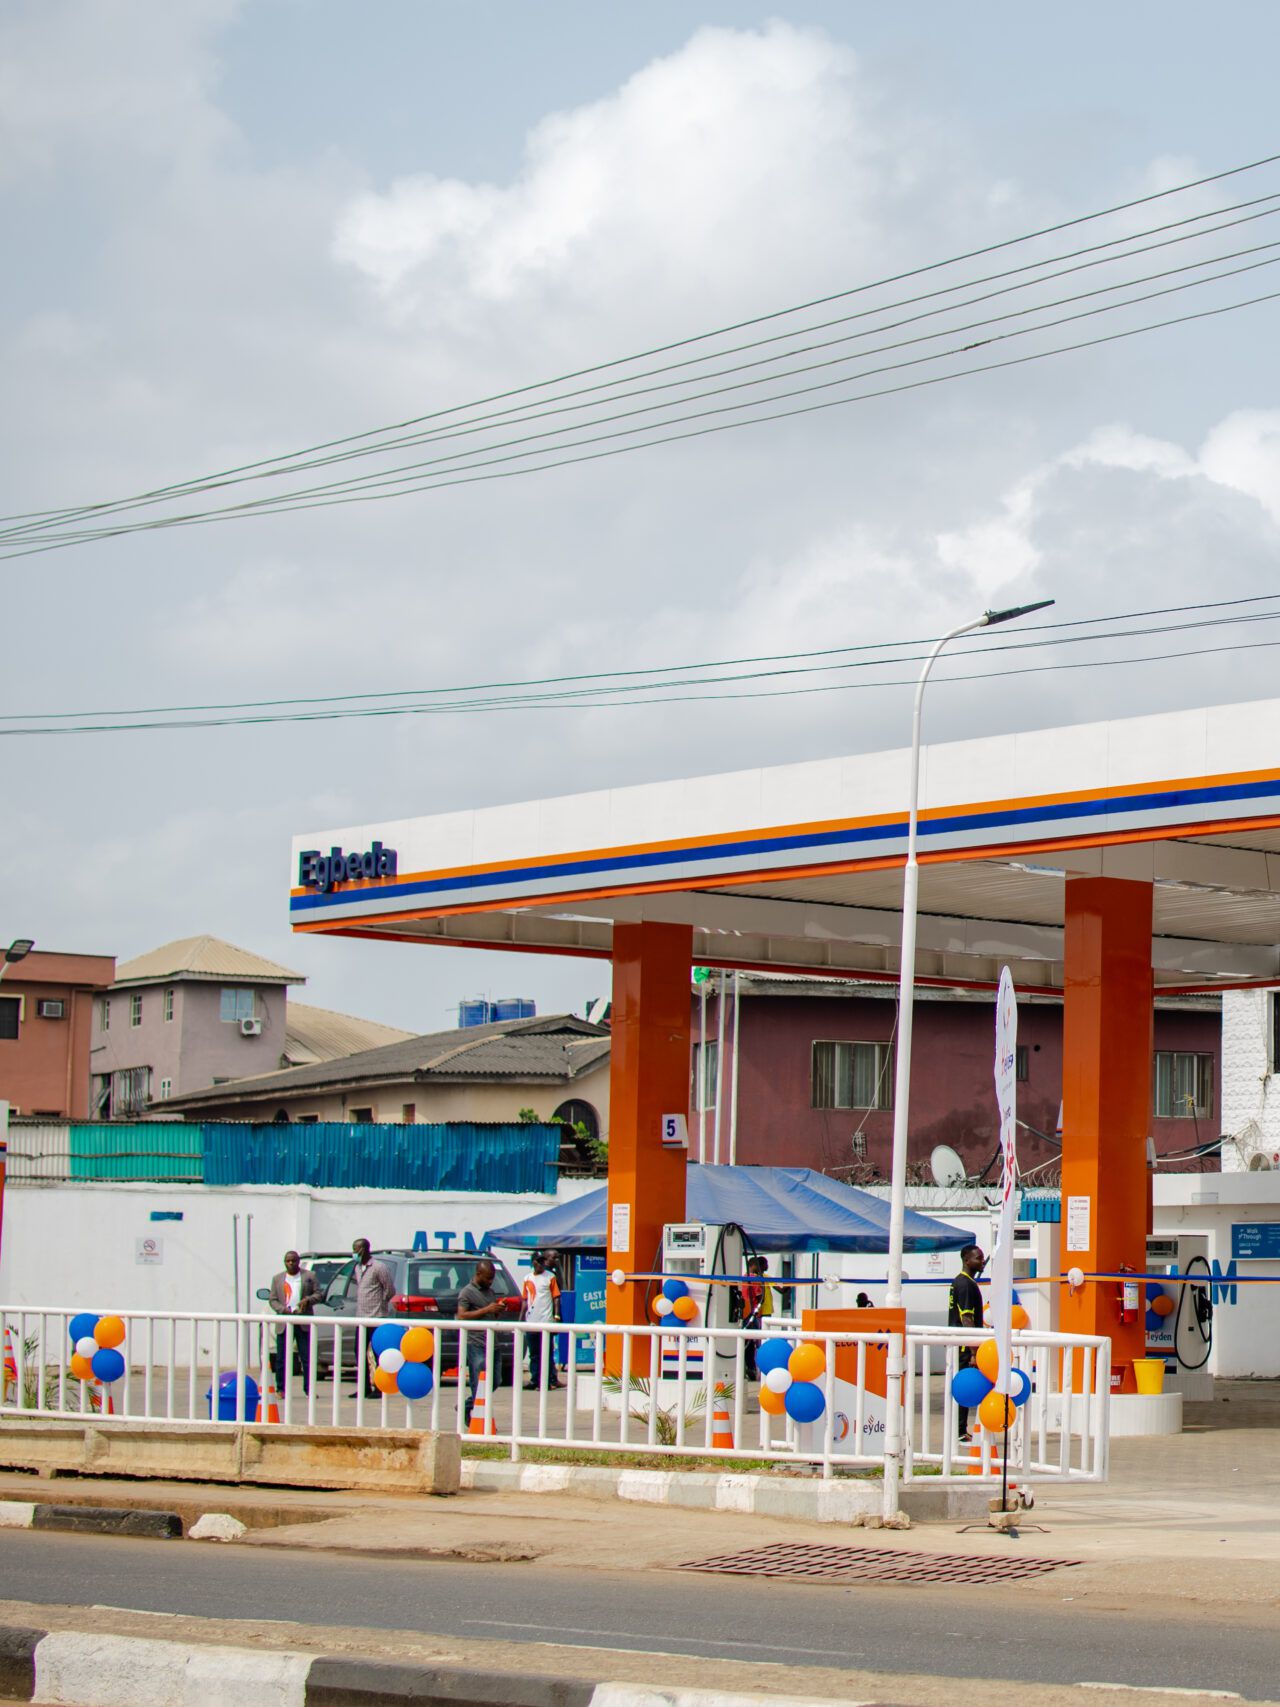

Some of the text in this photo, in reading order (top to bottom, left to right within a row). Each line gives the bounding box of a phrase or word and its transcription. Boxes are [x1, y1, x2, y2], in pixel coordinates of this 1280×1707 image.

[298, 841, 397, 893] Egbeda
[667, 1119, 676, 1137] 5
[411, 1230, 492, 1256] ATM
[583, 1290, 603, 1302] EASY
[854, 1419, 886, 1435] eyde
